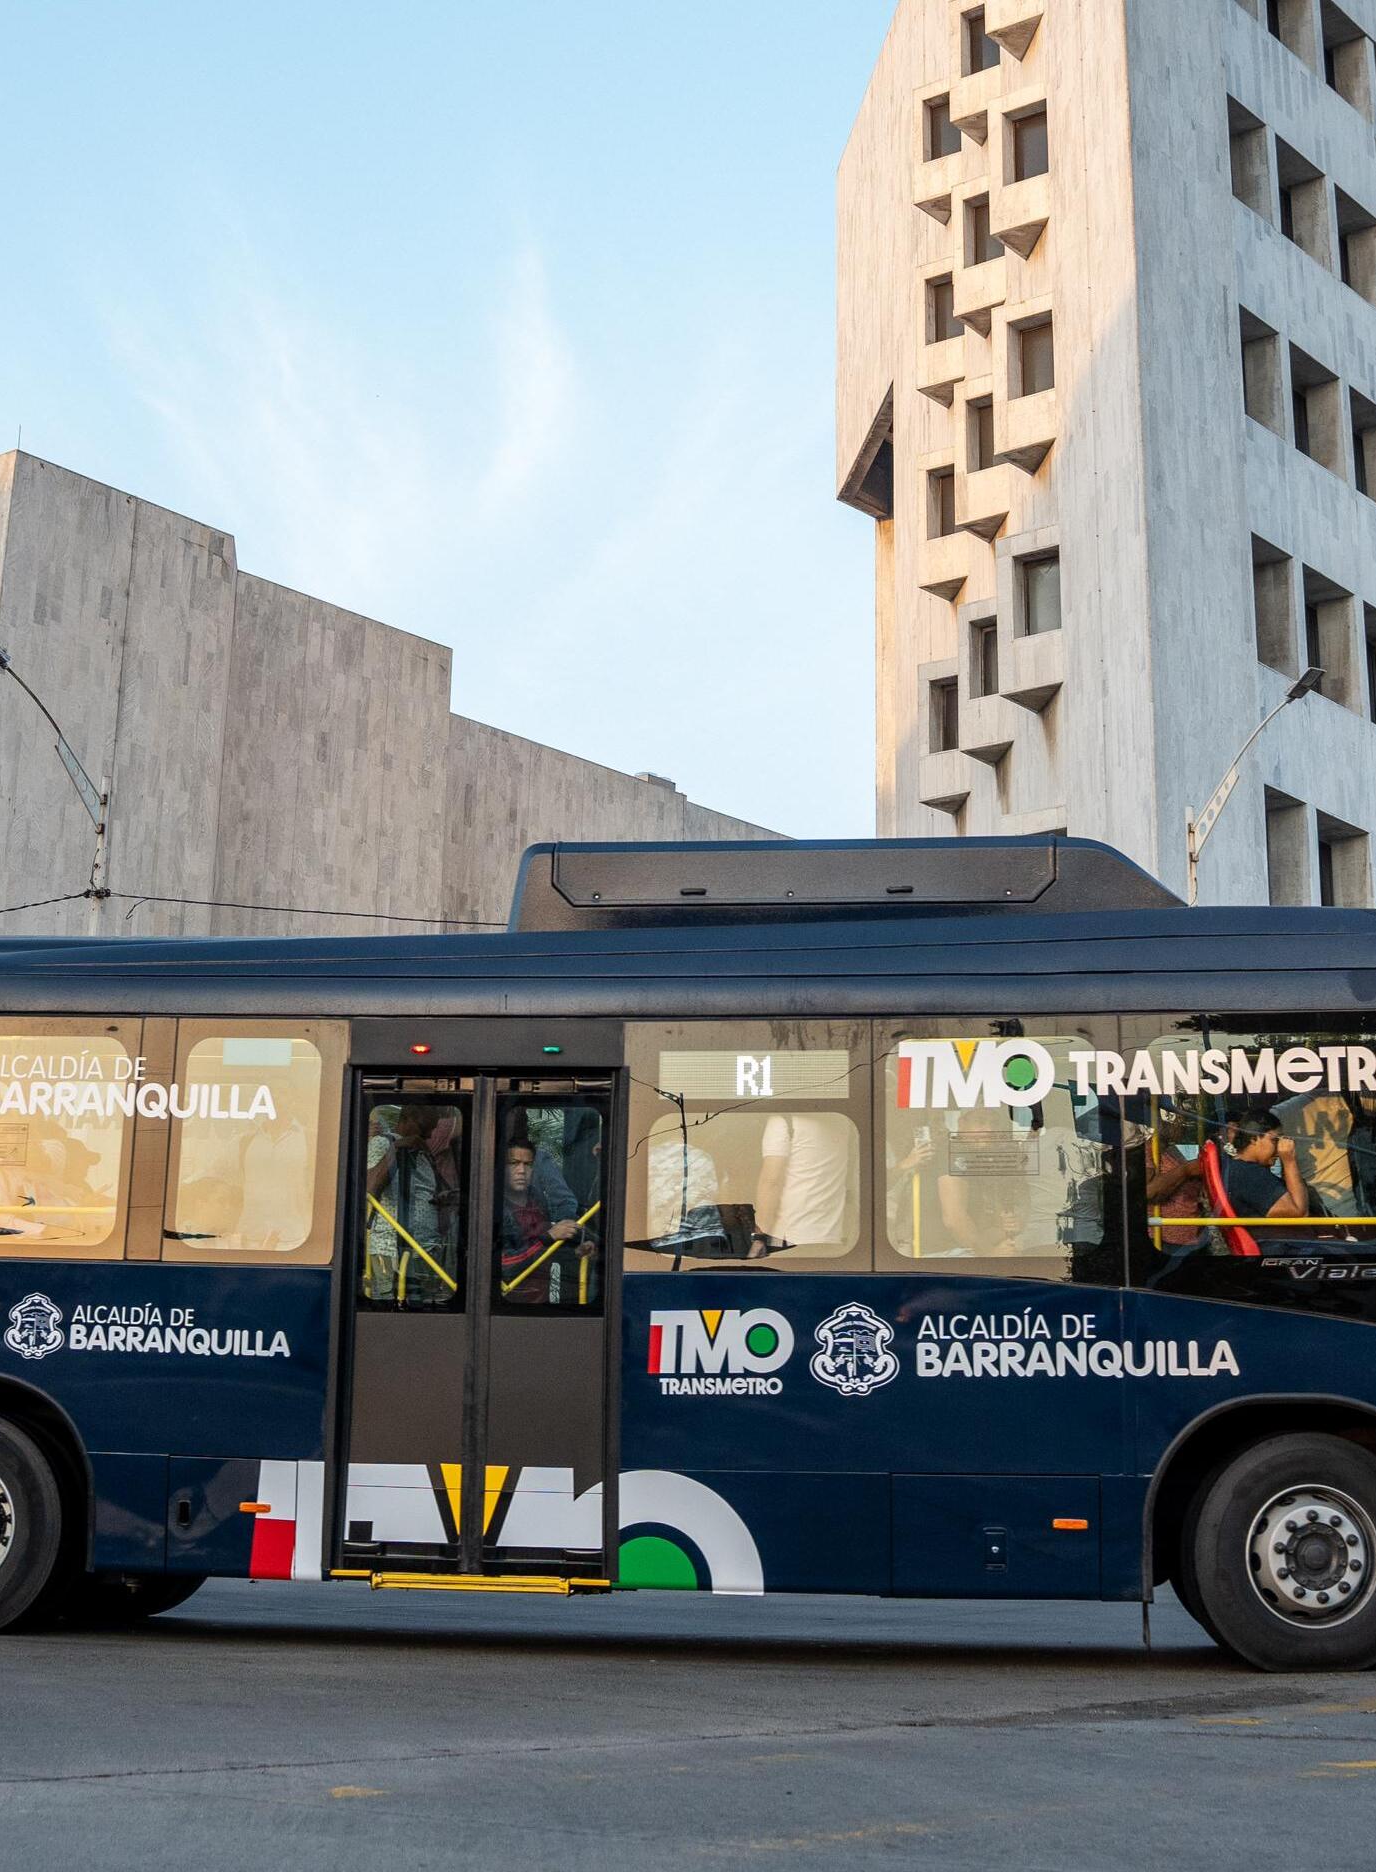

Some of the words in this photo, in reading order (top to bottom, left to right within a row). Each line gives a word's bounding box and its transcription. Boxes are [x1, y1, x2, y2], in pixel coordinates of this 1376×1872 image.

[114, 1056, 147, 1081] DE
[736, 1055, 773, 1096] R1
[897, 1038, 1056, 1109] TMO
[72, 1303, 163, 1327] ALCALDÍA
[170, 1308, 195, 1327] DE
[917, 1307, 1051, 1340] ALCALDÍA
[1062, 1314, 1097, 1339] DE
[69, 1324, 291, 1358] BARRANQUILLA
[647, 1308, 795, 1374] TMO
[916, 1340, 1240, 1379] BARRANQUILLA
